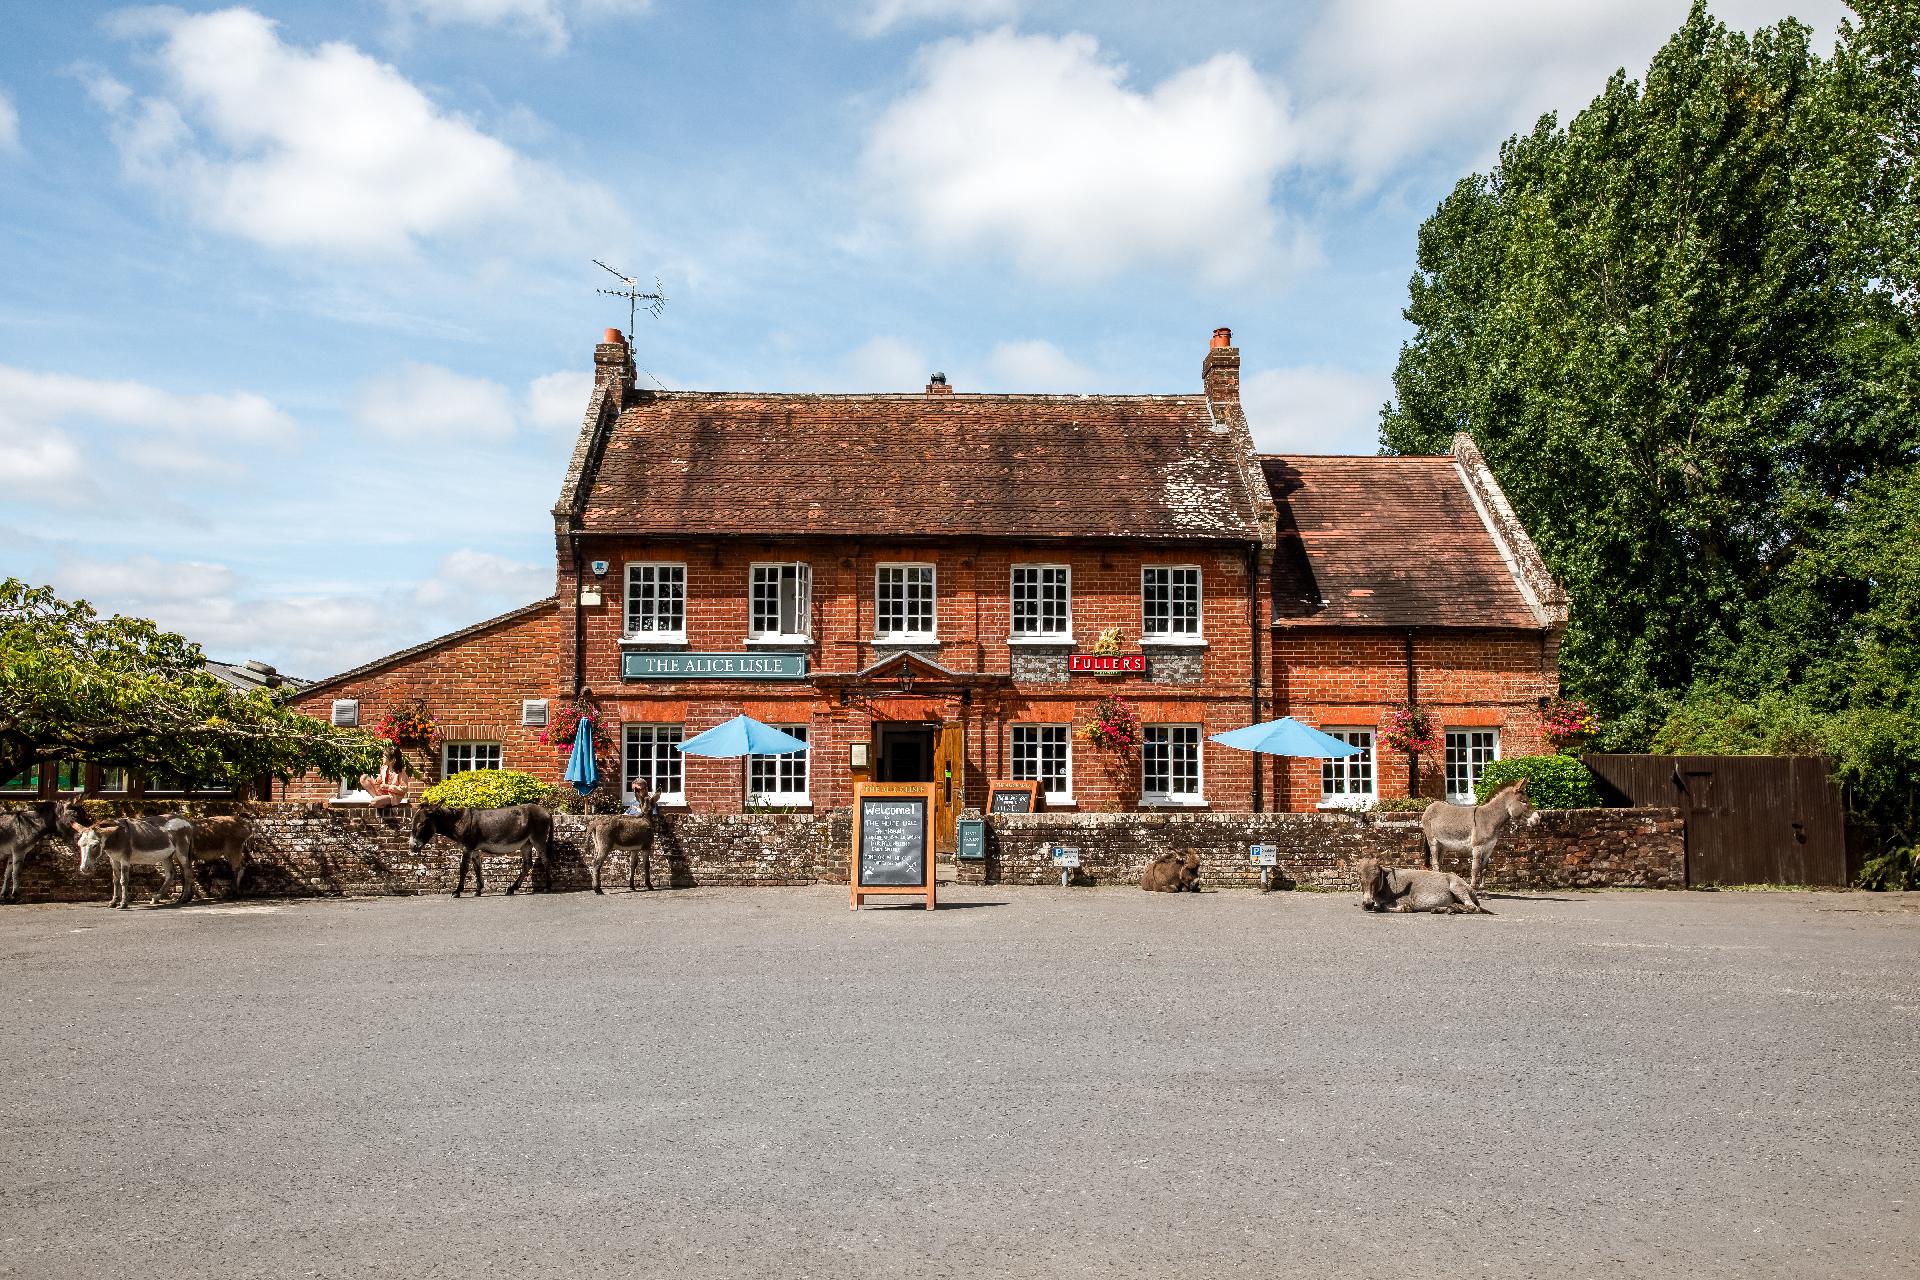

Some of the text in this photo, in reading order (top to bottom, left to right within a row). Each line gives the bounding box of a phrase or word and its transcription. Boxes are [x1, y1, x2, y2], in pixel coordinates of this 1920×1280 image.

[646, 658, 783, 673] THE ALICE LISLE
[1073, 656, 1141, 671] FULLER'S
